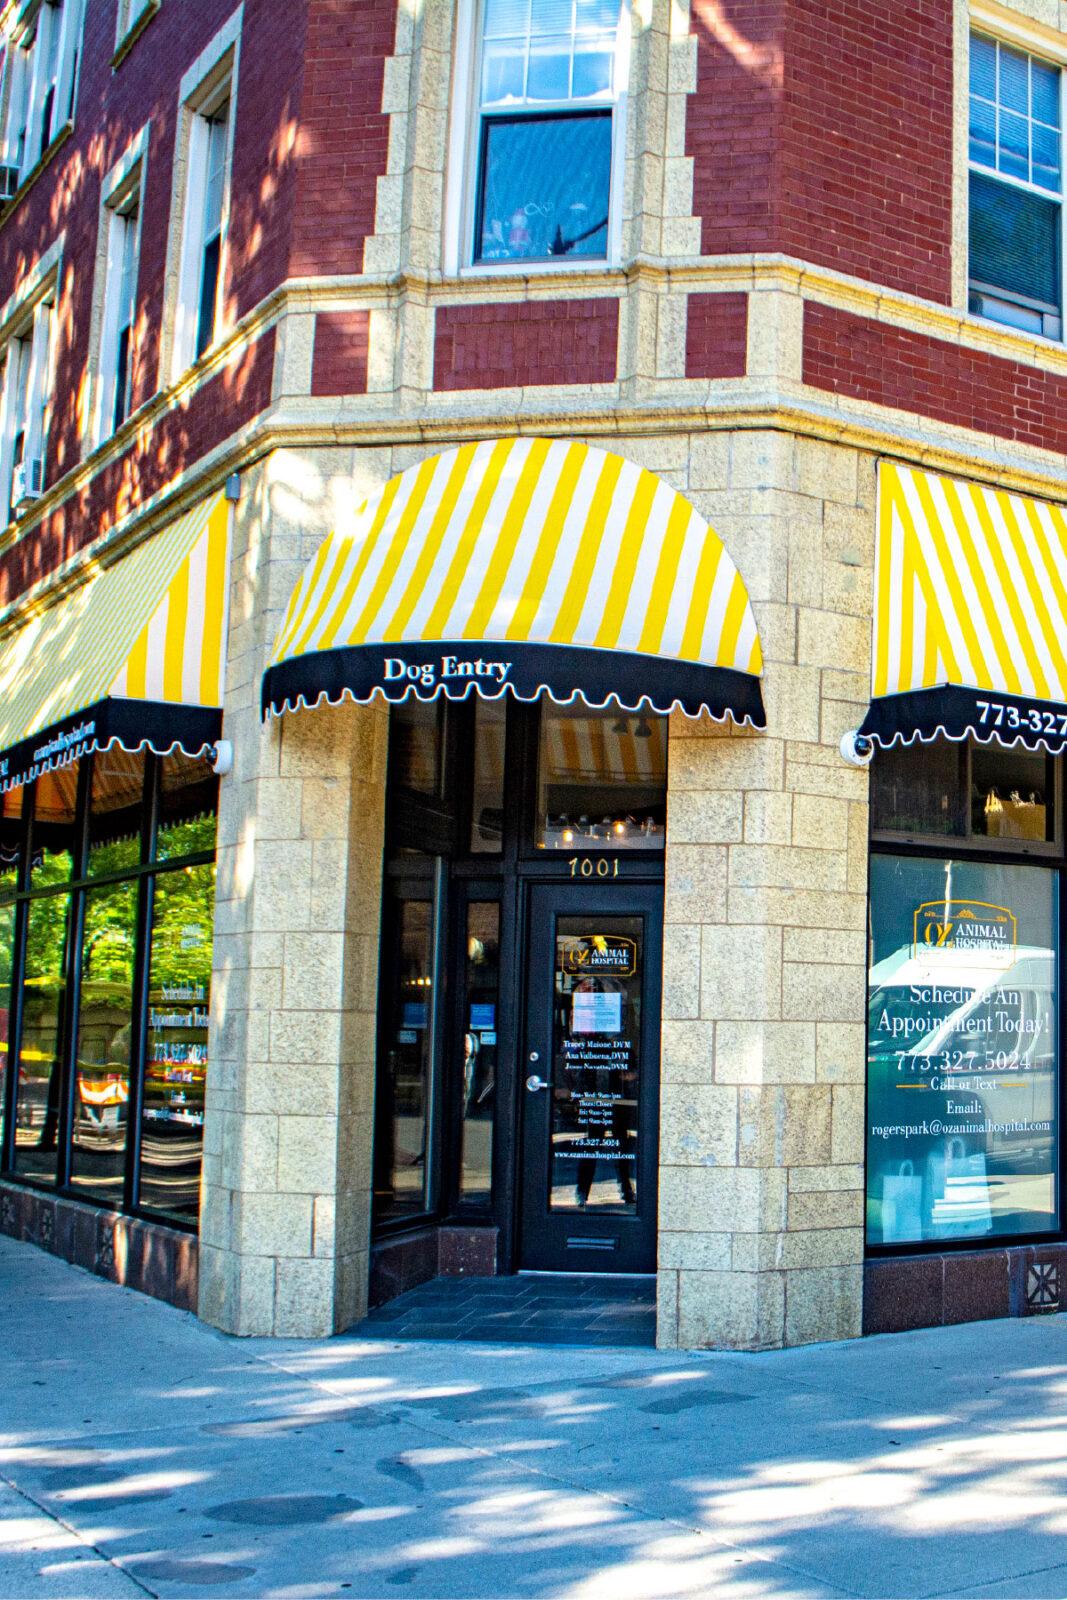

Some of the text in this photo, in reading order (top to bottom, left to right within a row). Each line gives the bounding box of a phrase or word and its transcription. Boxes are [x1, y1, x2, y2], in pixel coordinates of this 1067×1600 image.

[384, 655, 512, 686] Dog Entry
[955, 923, 1007, 938] ANIMAL
[591, 948, 629, 957] ANIMAL
[591, 957, 629, 965] HOSPITAL
[909, 985, 1018, 1004] Schedue An
[877, 1009, 1050, 1037] Appoinment Today!
[895, 1051, 1031, 1071] 773.327.5024
[930, 1076, 997, 1090] Call or Text
[946, 1100, 982, 1114] Email:
[872, 1118, 1050, 1139] rogerspark@ozanimalhospital.com
